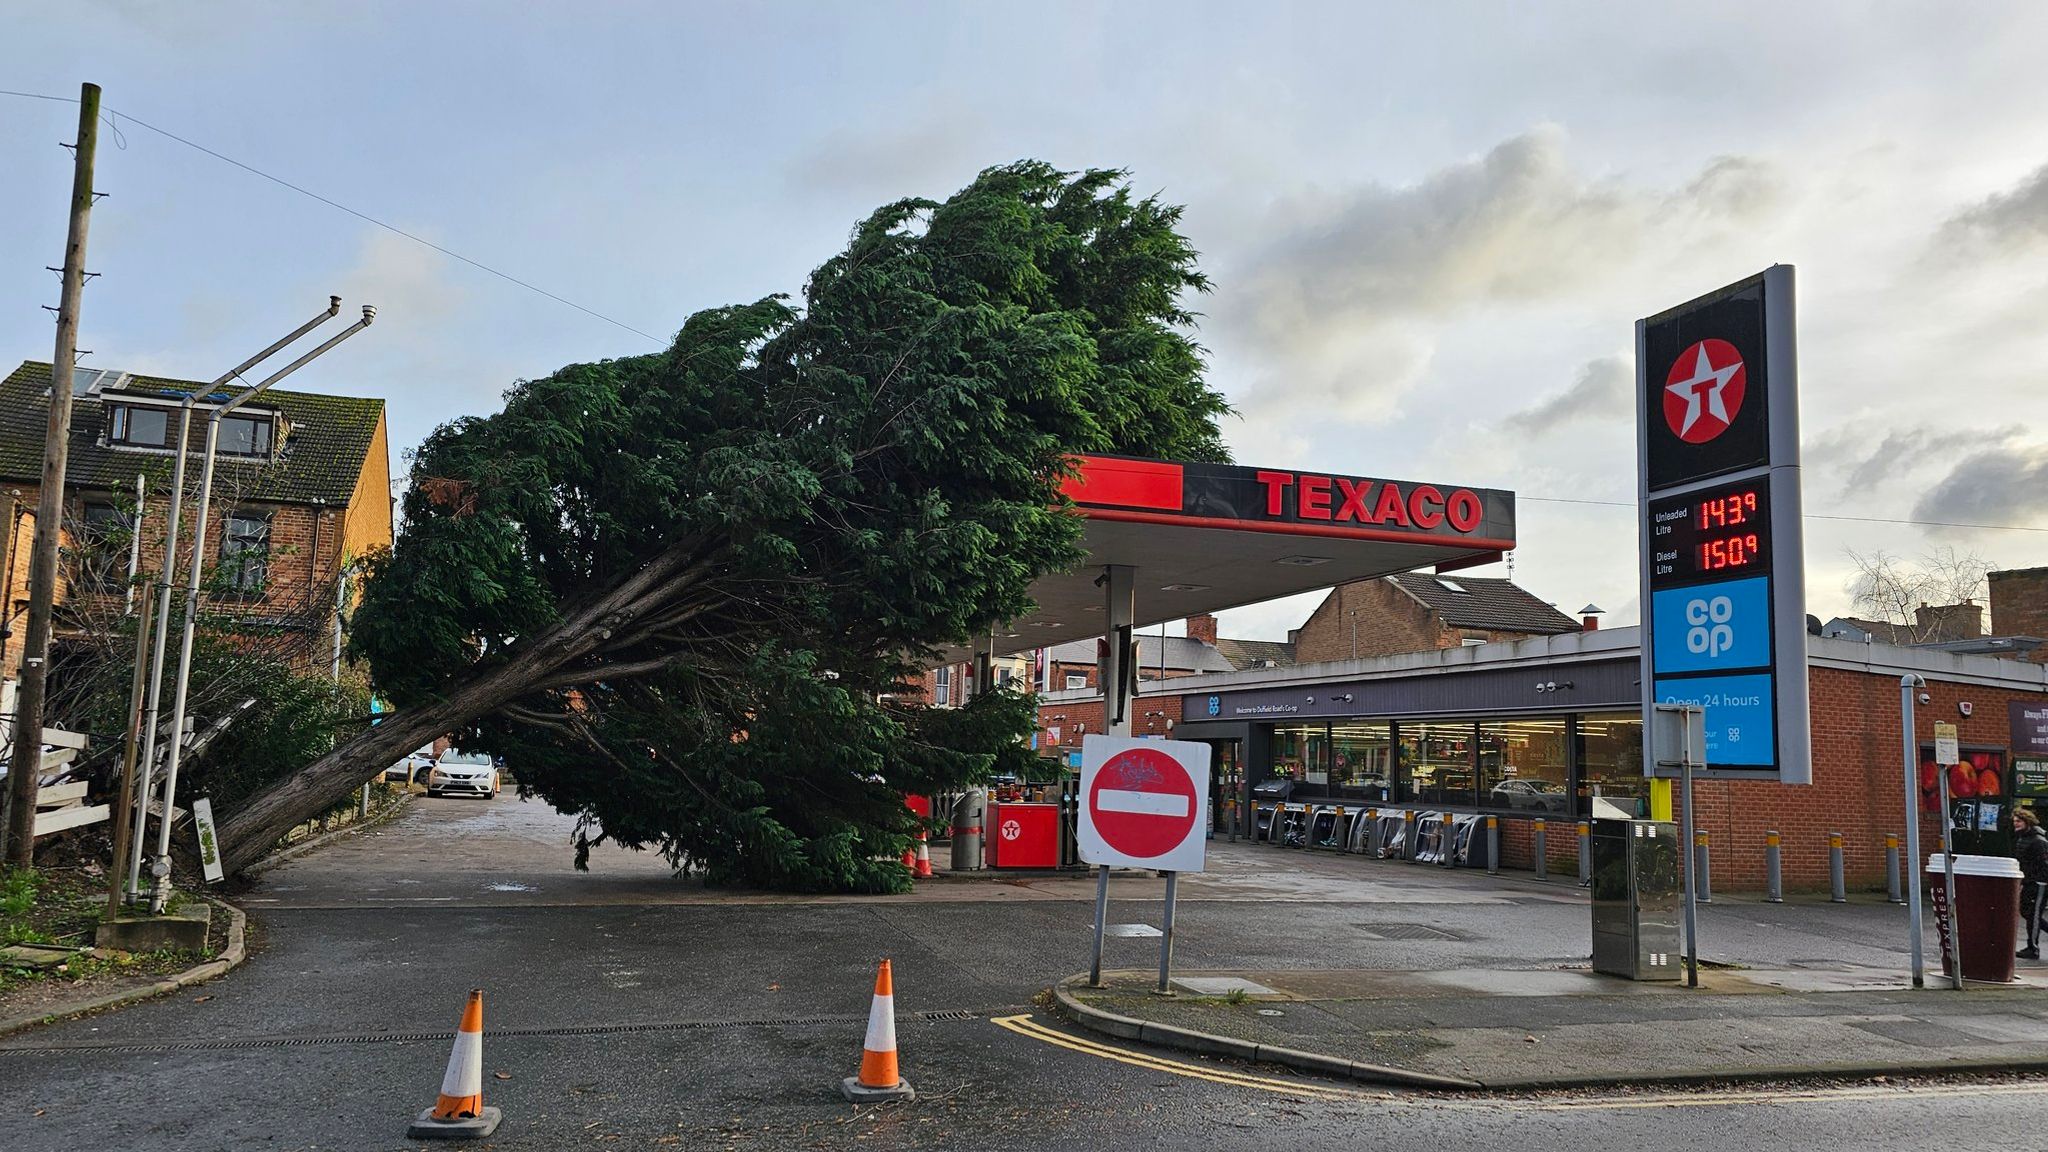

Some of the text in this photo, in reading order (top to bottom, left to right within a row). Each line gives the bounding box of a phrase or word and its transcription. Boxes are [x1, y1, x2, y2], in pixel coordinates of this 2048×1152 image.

[1256, 470, 1483, 532] TEXACO
[1656, 508, 1688, 523] Unleaded
[1702, 492, 1756, 530] 143.9
[1656, 525, 1672, 536] Litre
[1656, 550, 1678, 562] Diesel
[1703, 535, 1757, 570] 150.9
[1657, 565, 1673, 575] Litre
[1703, 694, 1720, 707] 24
[1723, 693, 1760, 706] hours
